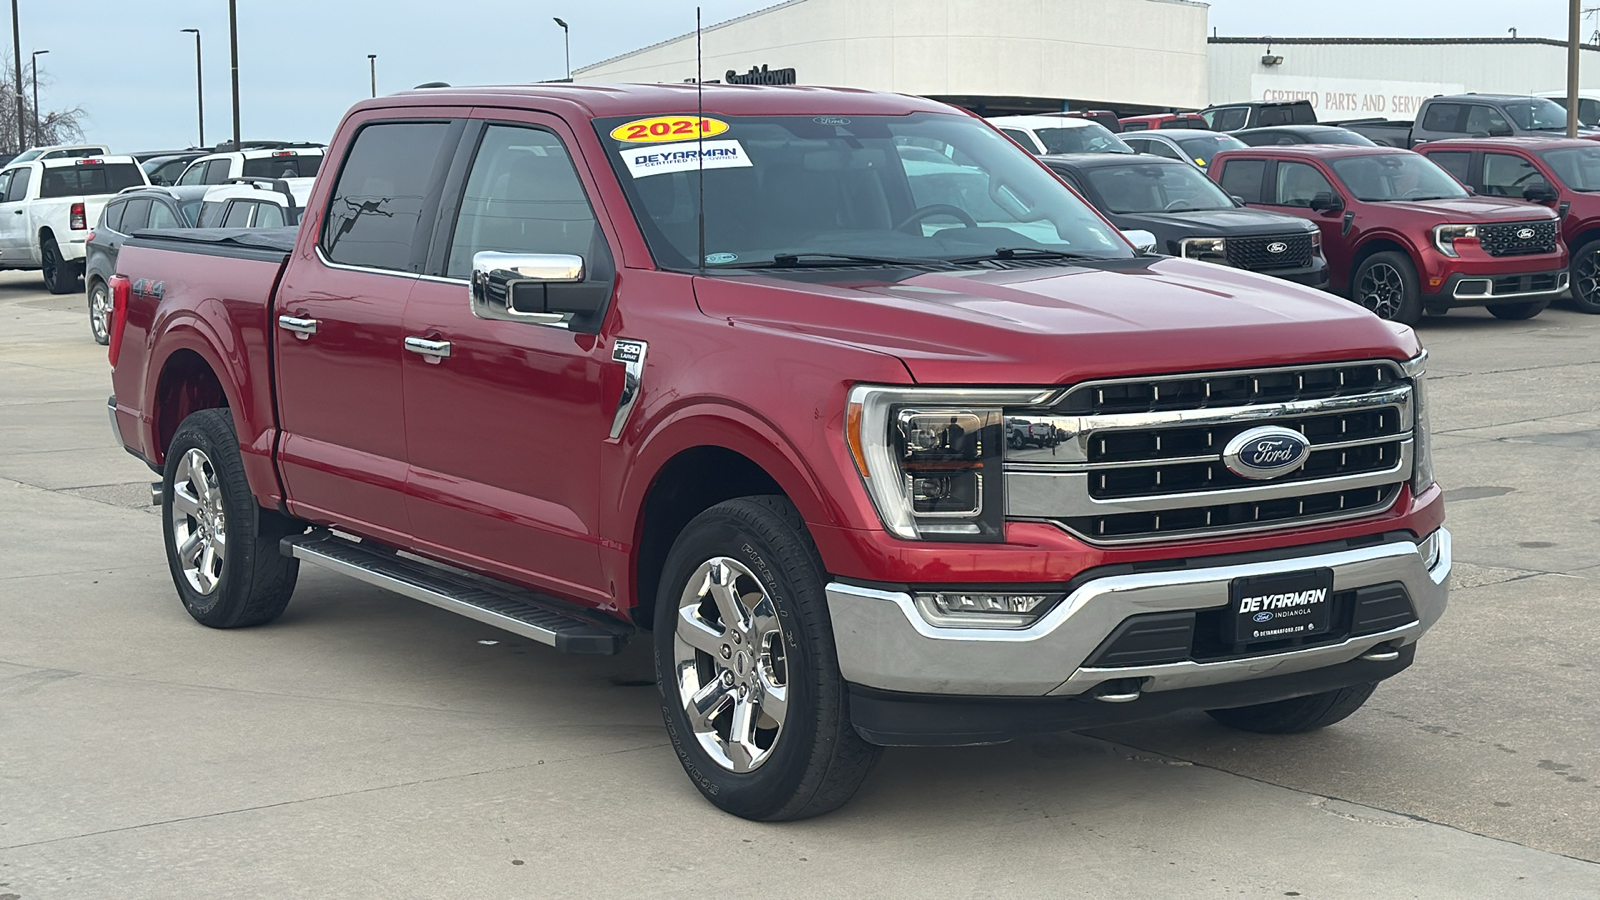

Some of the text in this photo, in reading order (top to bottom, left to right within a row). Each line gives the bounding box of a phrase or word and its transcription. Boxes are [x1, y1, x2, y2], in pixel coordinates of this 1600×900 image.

[725, 64, 796, 85] Southtown
[1263, 89, 1429, 113] CERTIFIED PARTS AND SERVI
[627, 120, 711, 139] 2021
[635, 148, 737, 165] DEYARMAN
[645, 158, 688, 167] CERTIFIED
[1253, 441, 1293, 464] Ford
[1239, 588, 1327, 613] DEYARMAN
[1275, 608, 1311, 618] INDIANOLA
